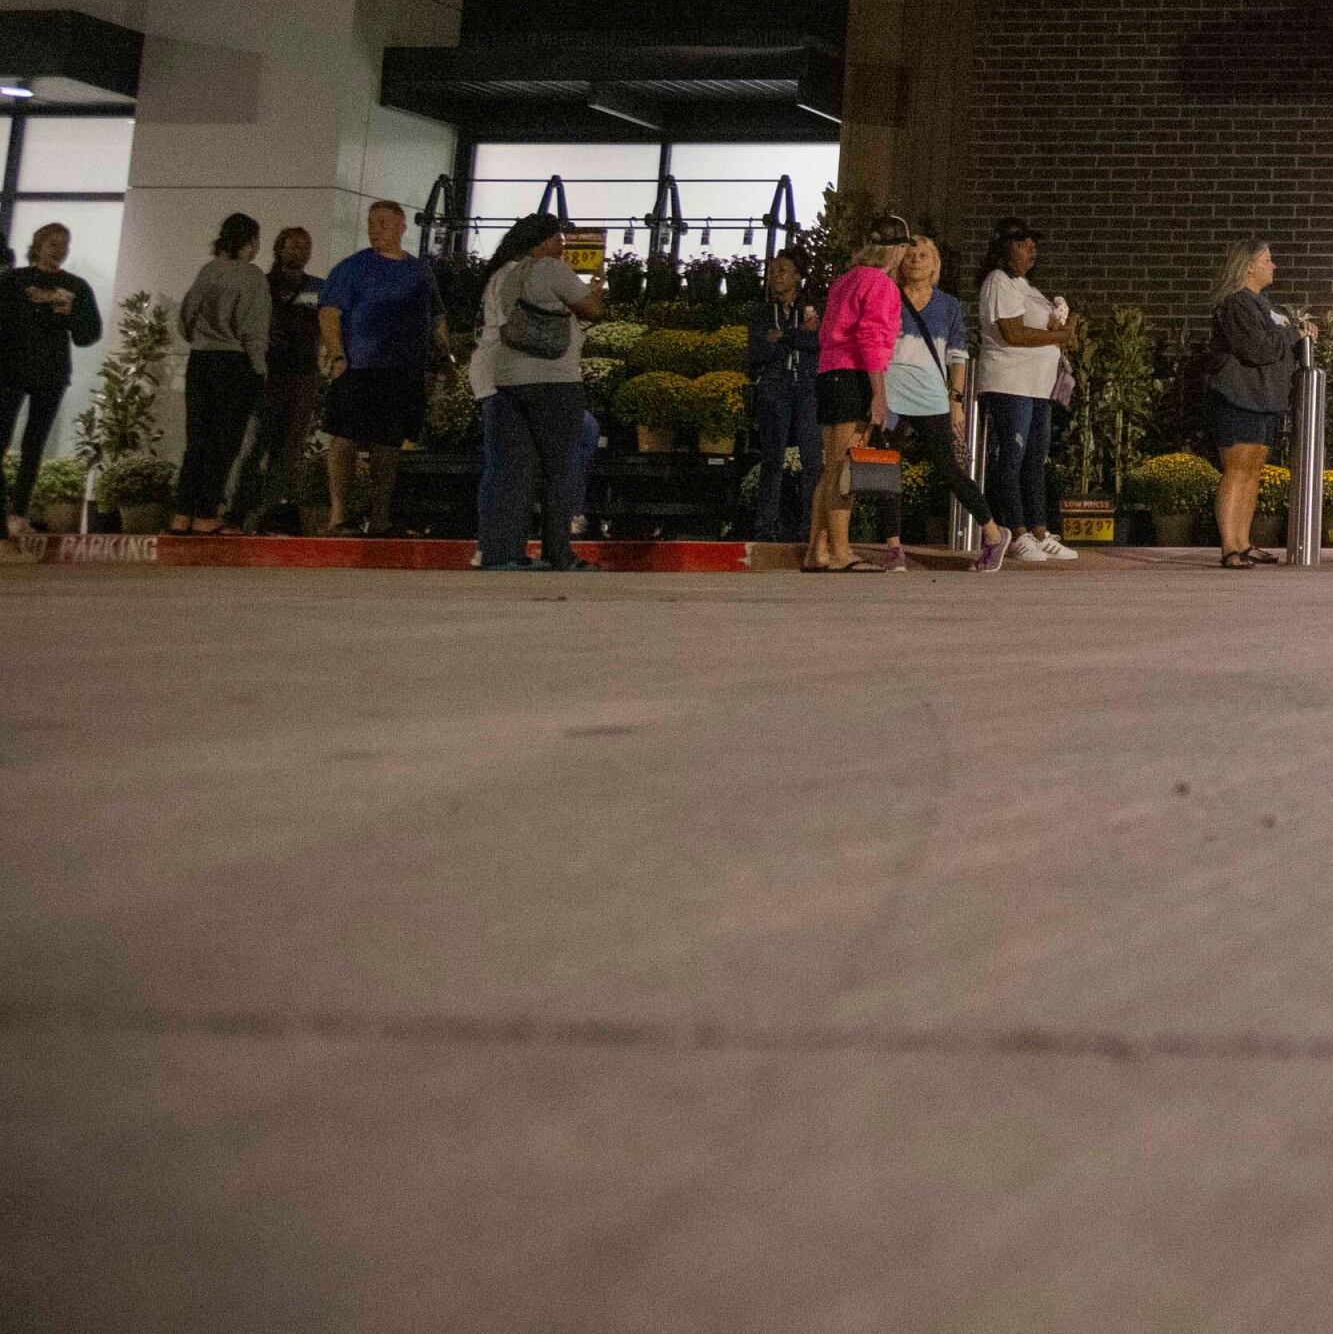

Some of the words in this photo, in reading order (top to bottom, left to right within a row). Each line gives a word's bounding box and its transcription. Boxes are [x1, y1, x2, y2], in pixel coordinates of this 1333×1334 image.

[1064, 500, 1081, 508] LOW
[1083, 500, 1109, 508] PRICES
[59, 535, 158, 562] PARKING
